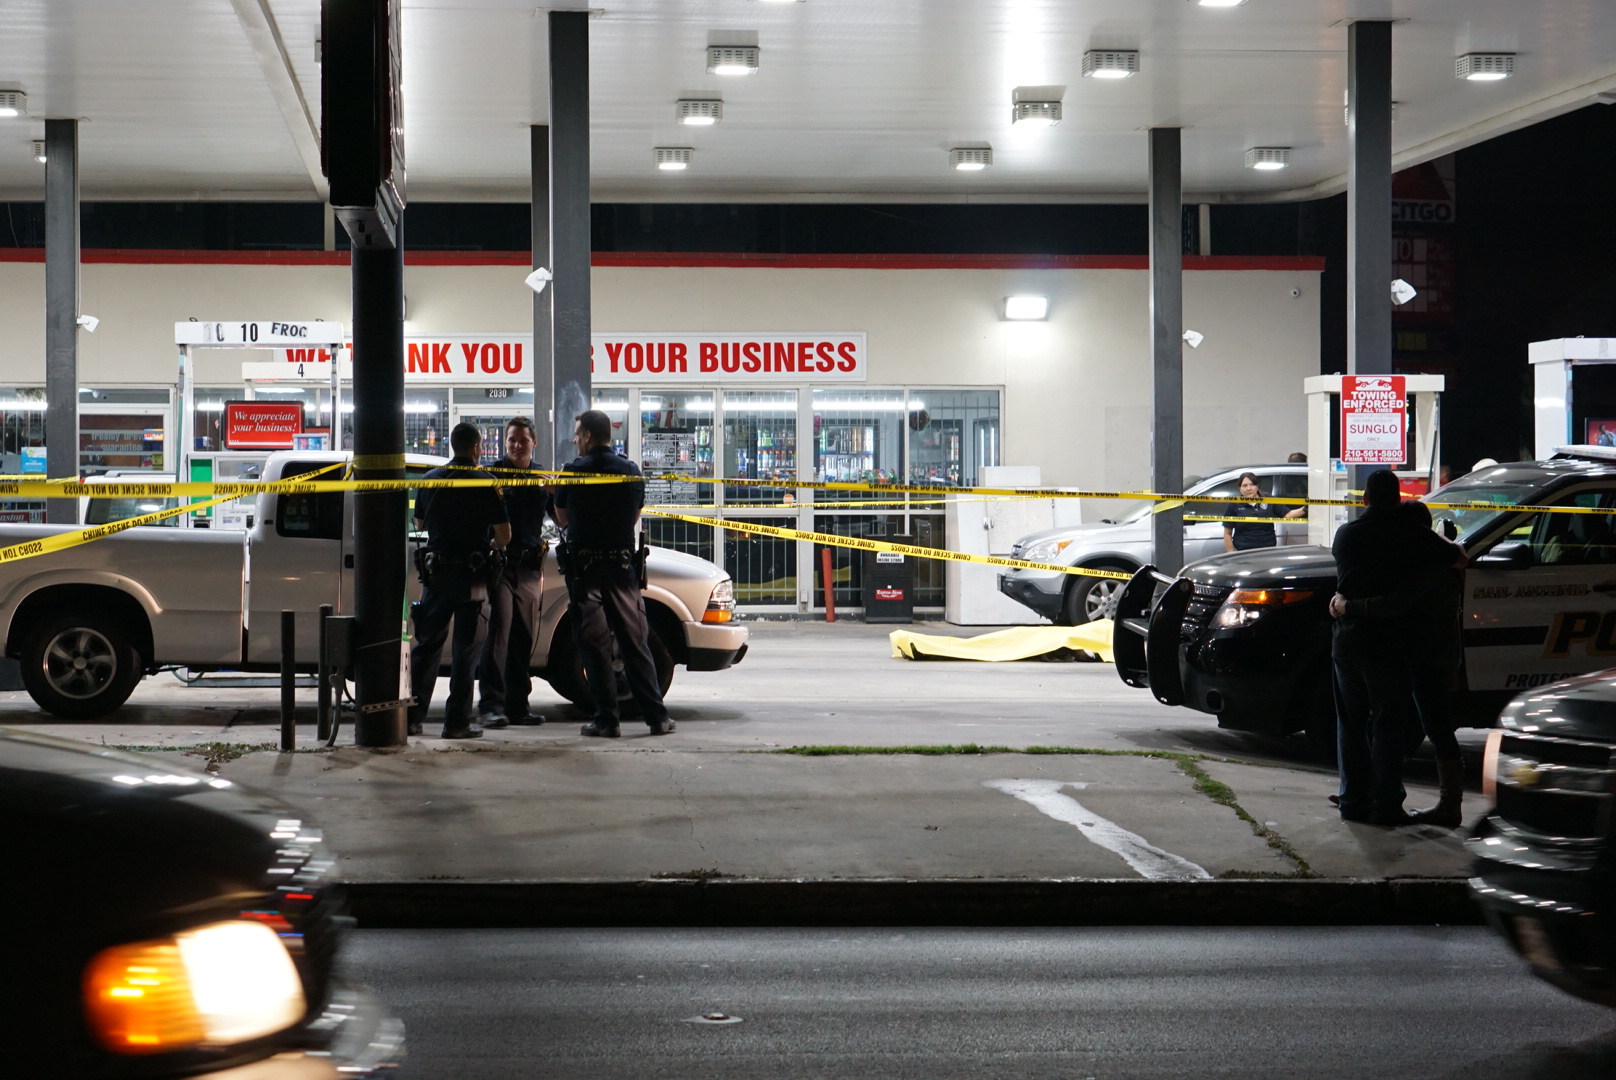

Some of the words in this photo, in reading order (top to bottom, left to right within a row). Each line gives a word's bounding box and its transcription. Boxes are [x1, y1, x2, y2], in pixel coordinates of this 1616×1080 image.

[1392, 202, 1452, 222] CITGO
[241, 323, 258, 342] 10
[461, 342, 523, 374] YOU
[604, 342, 688, 374] YOUR
[699, 341, 857, 373] BUSINESS
[298, 363, 304, 377] 4
[489, 388, 507, 398] 2030
[1350, 391, 1397, 400] TOWING
[1343, 400, 1404, 409] ENFORCED
[235, 411, 247, 420] We
[250, 411, 296, 423] appreciate
[232, 424, 253, 434] your
[255, 422, 297, 432] business!
[1349, 424, 1398, 434] SUNGLO
[1473, 586, 1512, 599] SAN
[1513, 584, 1593, 598] ANTONIO
